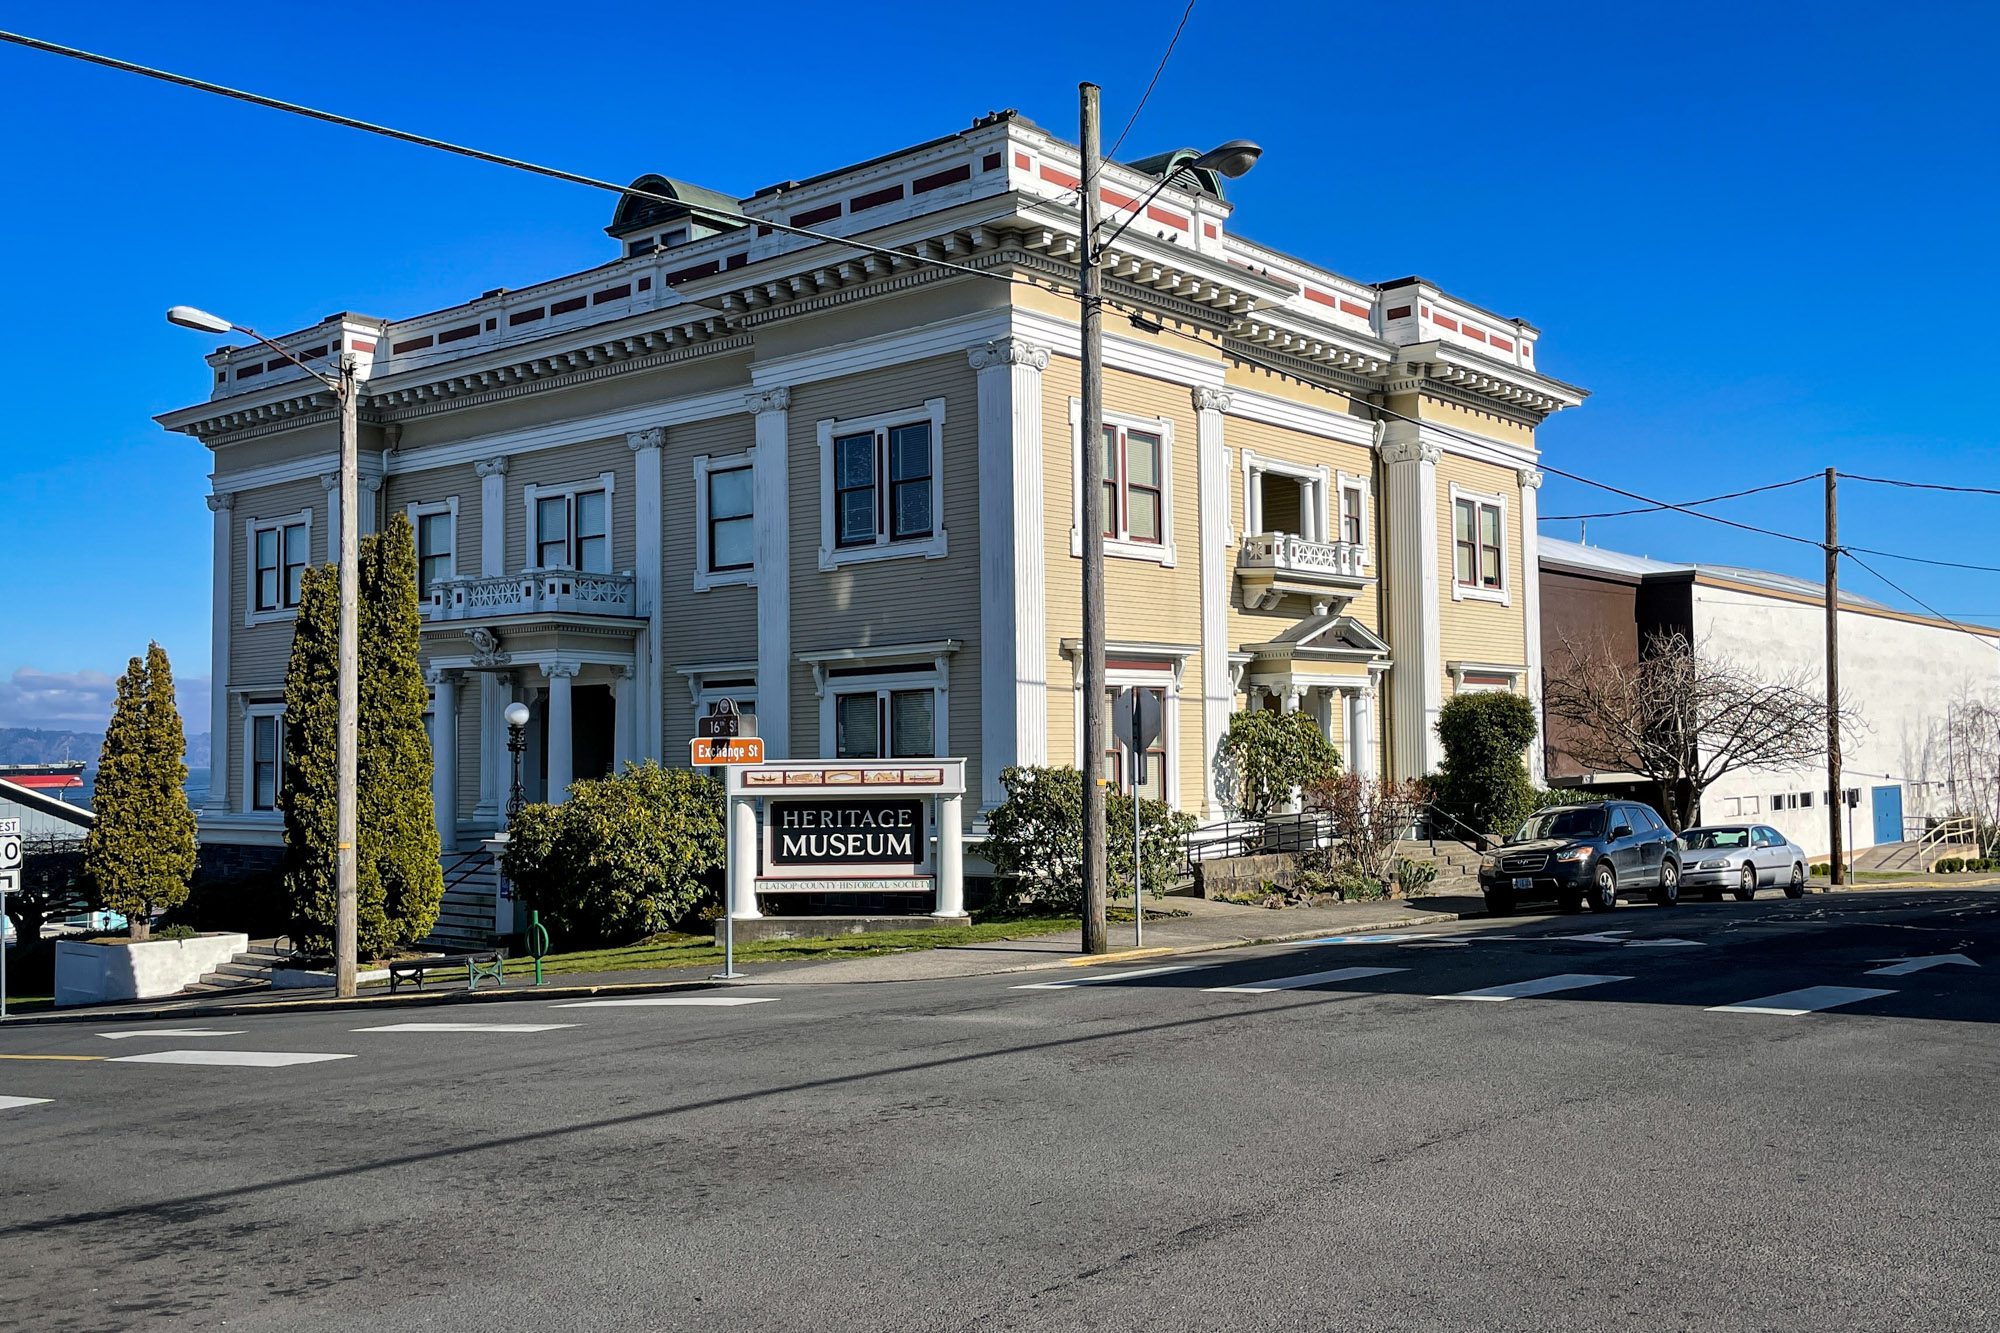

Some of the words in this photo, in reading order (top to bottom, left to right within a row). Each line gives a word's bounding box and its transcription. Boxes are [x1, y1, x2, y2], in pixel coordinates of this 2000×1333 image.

[698, 744, 744, 761] Exchange
[748, 744, 758, 757] St
[783, 809, 912, 828] HERITAGE
[0, 842, 18, 860] 0
[782, 833, 912, 857] MUSEUM
[800, 882, 837, 890] COUNTY
[839, 881, 888, 889] HISTORICAL
[893, 881, 931, 889] SOCIETY
